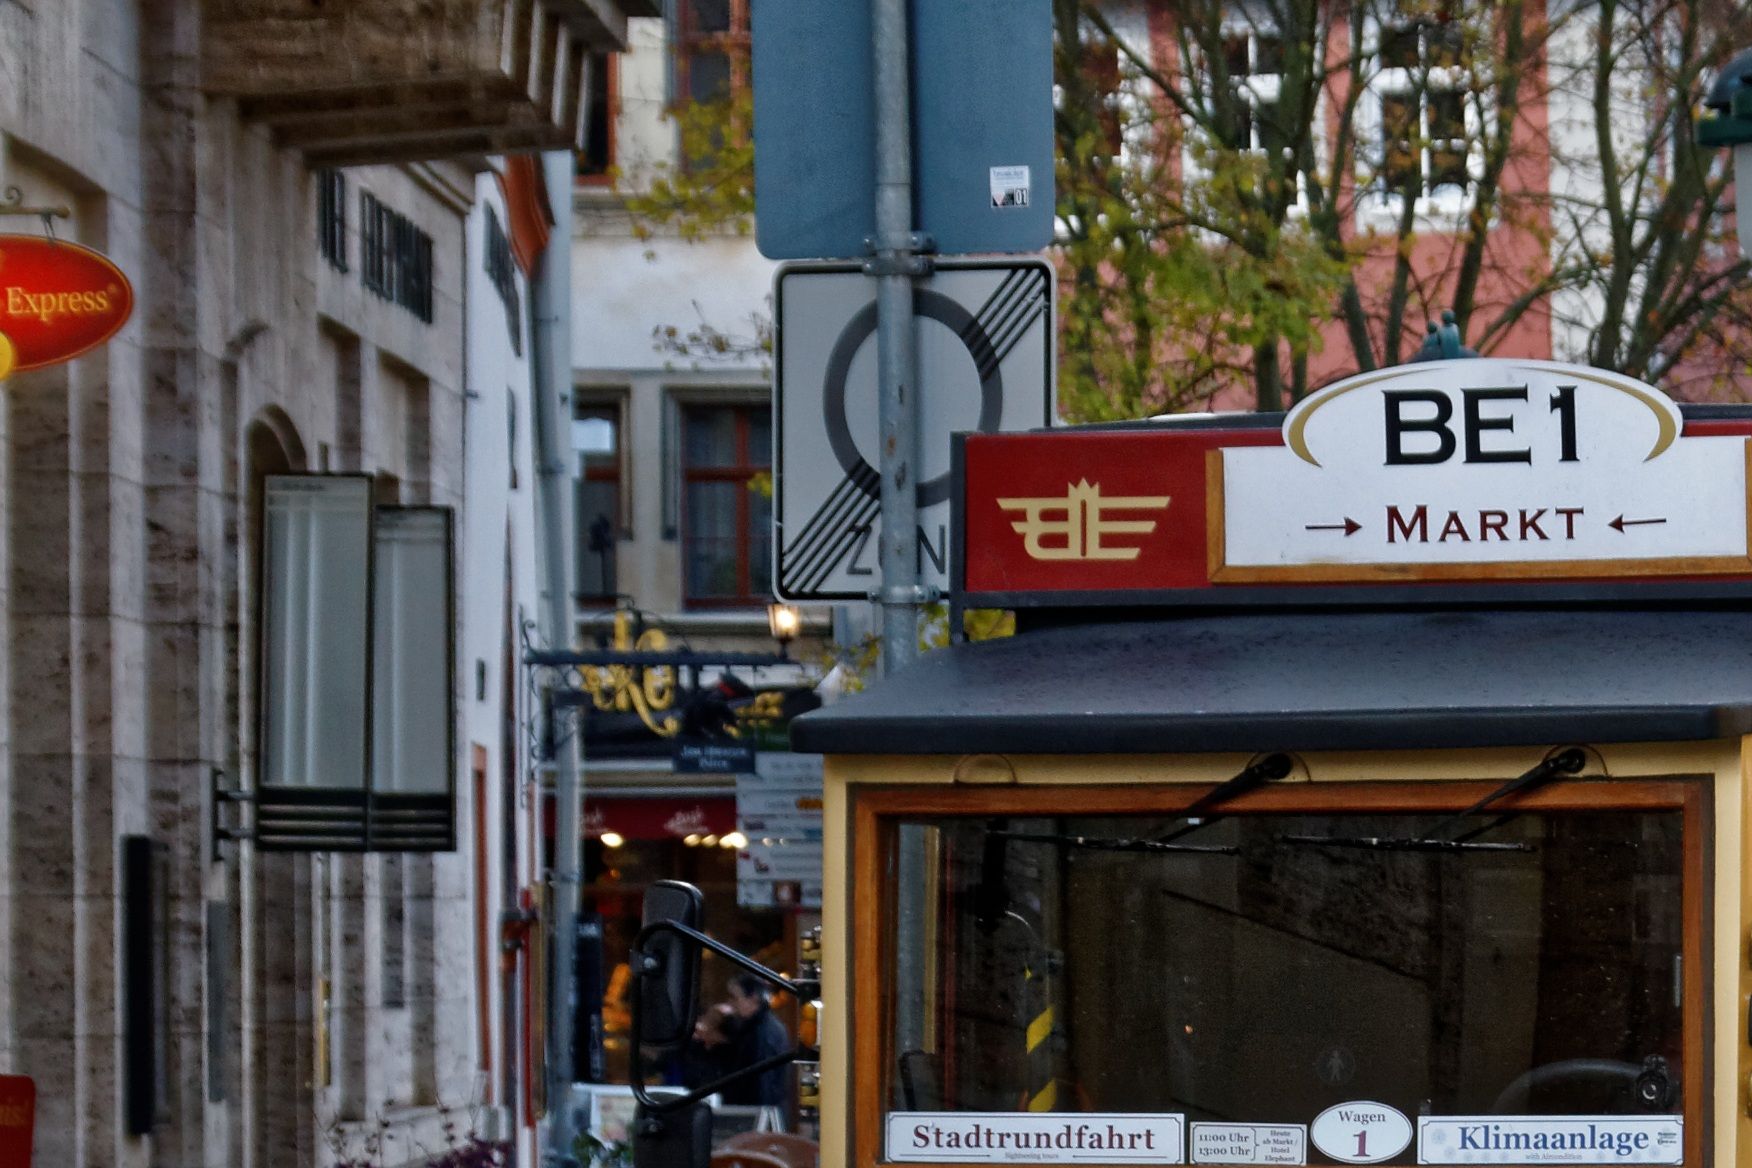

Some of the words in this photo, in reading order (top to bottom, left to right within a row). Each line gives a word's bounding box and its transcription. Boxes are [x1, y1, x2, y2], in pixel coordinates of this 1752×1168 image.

[5, 286, 109, 322] Express
[1385, 503, 1585, 545] MARKT
[1338, 1110, 1387, 1125] Wagen
[912, 1123, 1156, 1151] Stadtrundfahrt
[1199, 1133, 1227, 1143] 11:00
[1229, 1132, 1250, 1143] Uhr
[1199, 1146, 1228, 1157] 13:00
[1230, 1145, 1251, 1156] Uhr
[1352, 1129, 1371, 1157] 1
[1458, 1124, 1650, 1156] Klimaanlage
